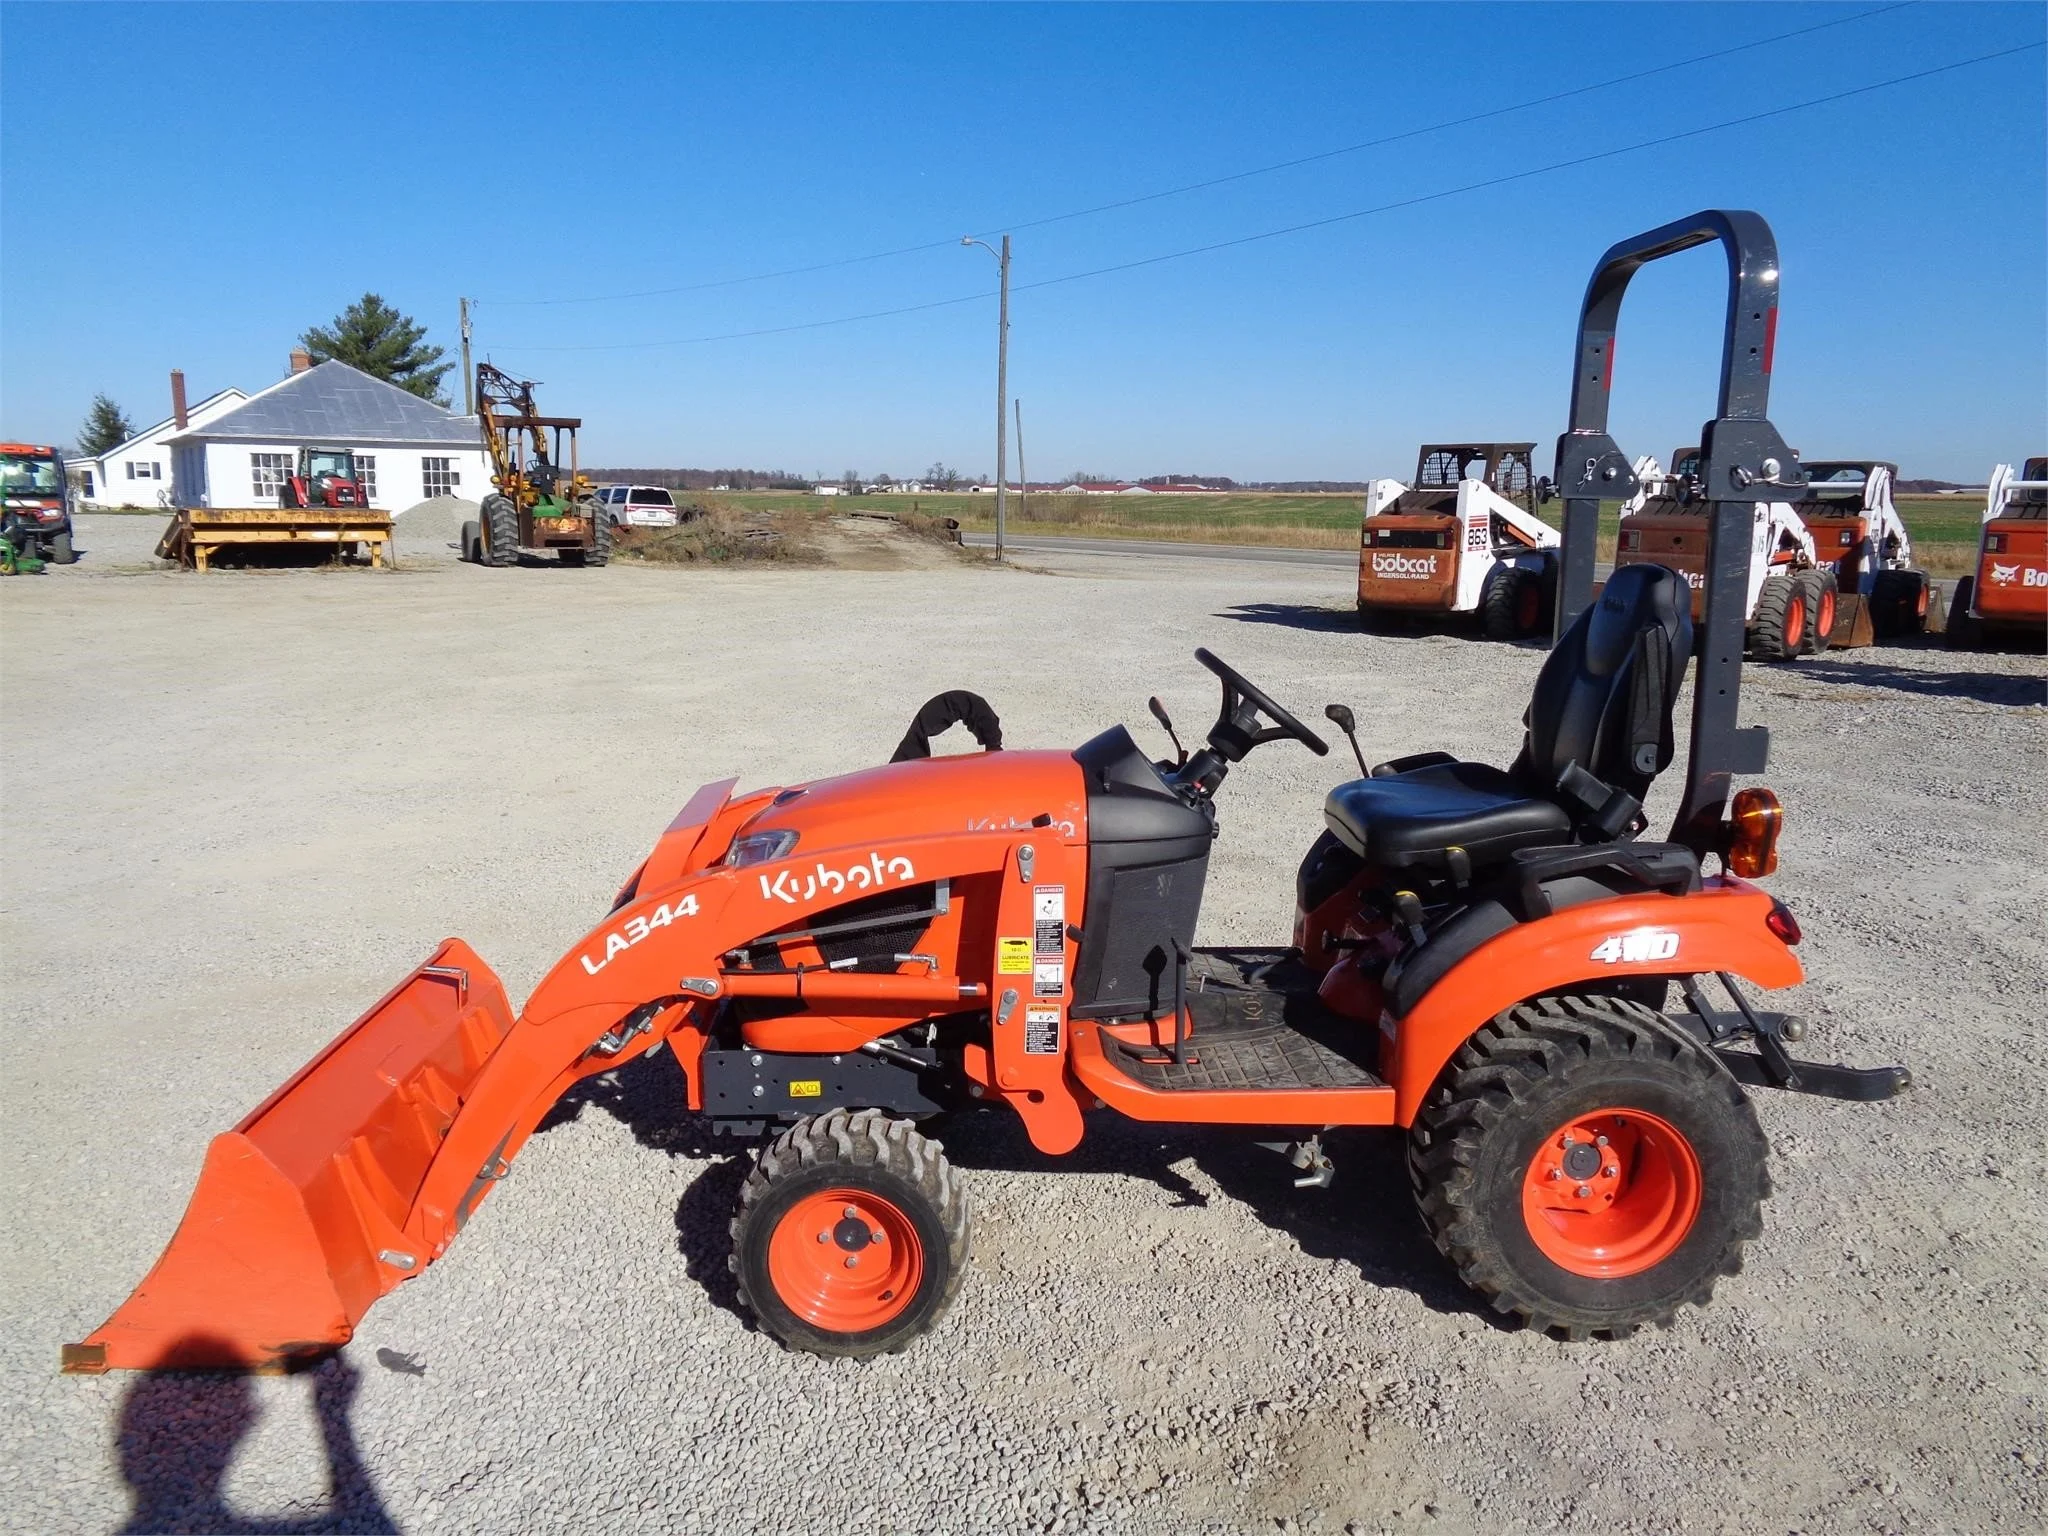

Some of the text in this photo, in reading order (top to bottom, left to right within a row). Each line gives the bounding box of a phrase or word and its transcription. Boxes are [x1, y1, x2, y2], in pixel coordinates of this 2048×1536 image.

[1467, 528, 1488, 546] 863
[1372, 552, 1438, 574] bobcat
[759, 851, 915, 905] Kubota
[580, 893, 700, 976] LA344
[1589, 930, 1681, 965] 4WD
